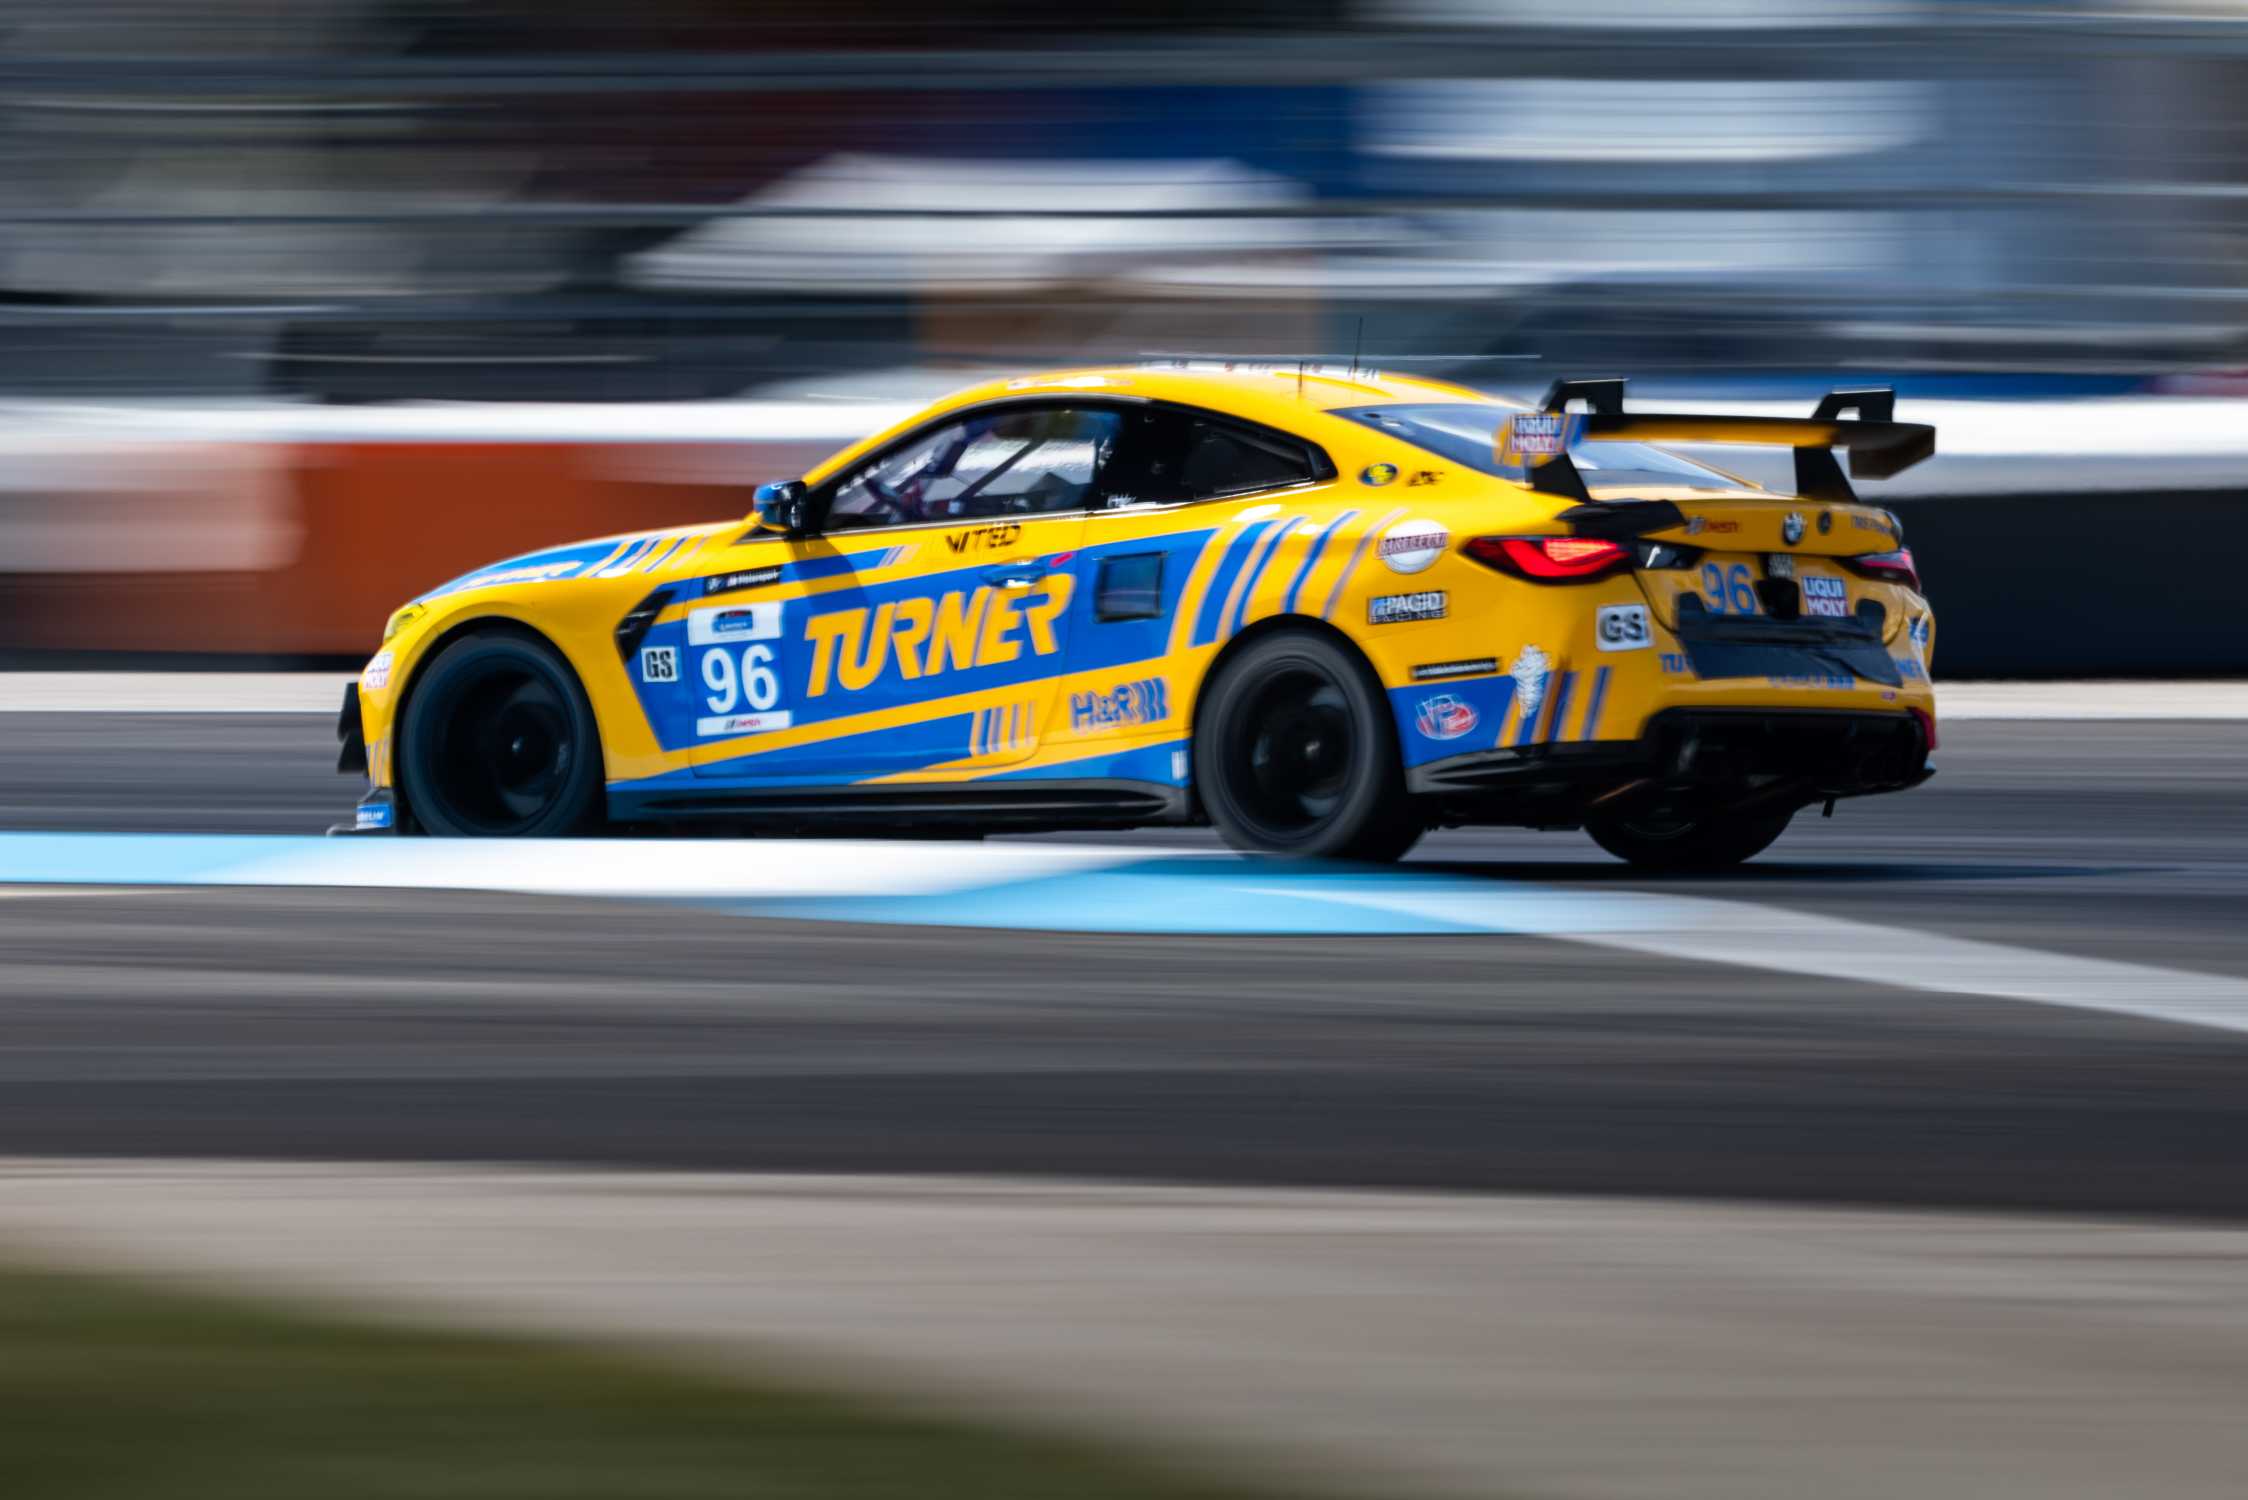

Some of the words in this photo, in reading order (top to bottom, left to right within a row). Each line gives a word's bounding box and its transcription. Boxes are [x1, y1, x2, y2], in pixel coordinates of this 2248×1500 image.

[1702, 563, 1757, 616] 96
[1803, 578, 1844, 598] LIQUI
[1807, 600, 1848, 617] MOLY
[804, 573, 1077, 699] TURNER
[1600, 612, 1647, 643] GS
[644, 650, 674, 679] GS
[701, 643, 779, 714] 96
